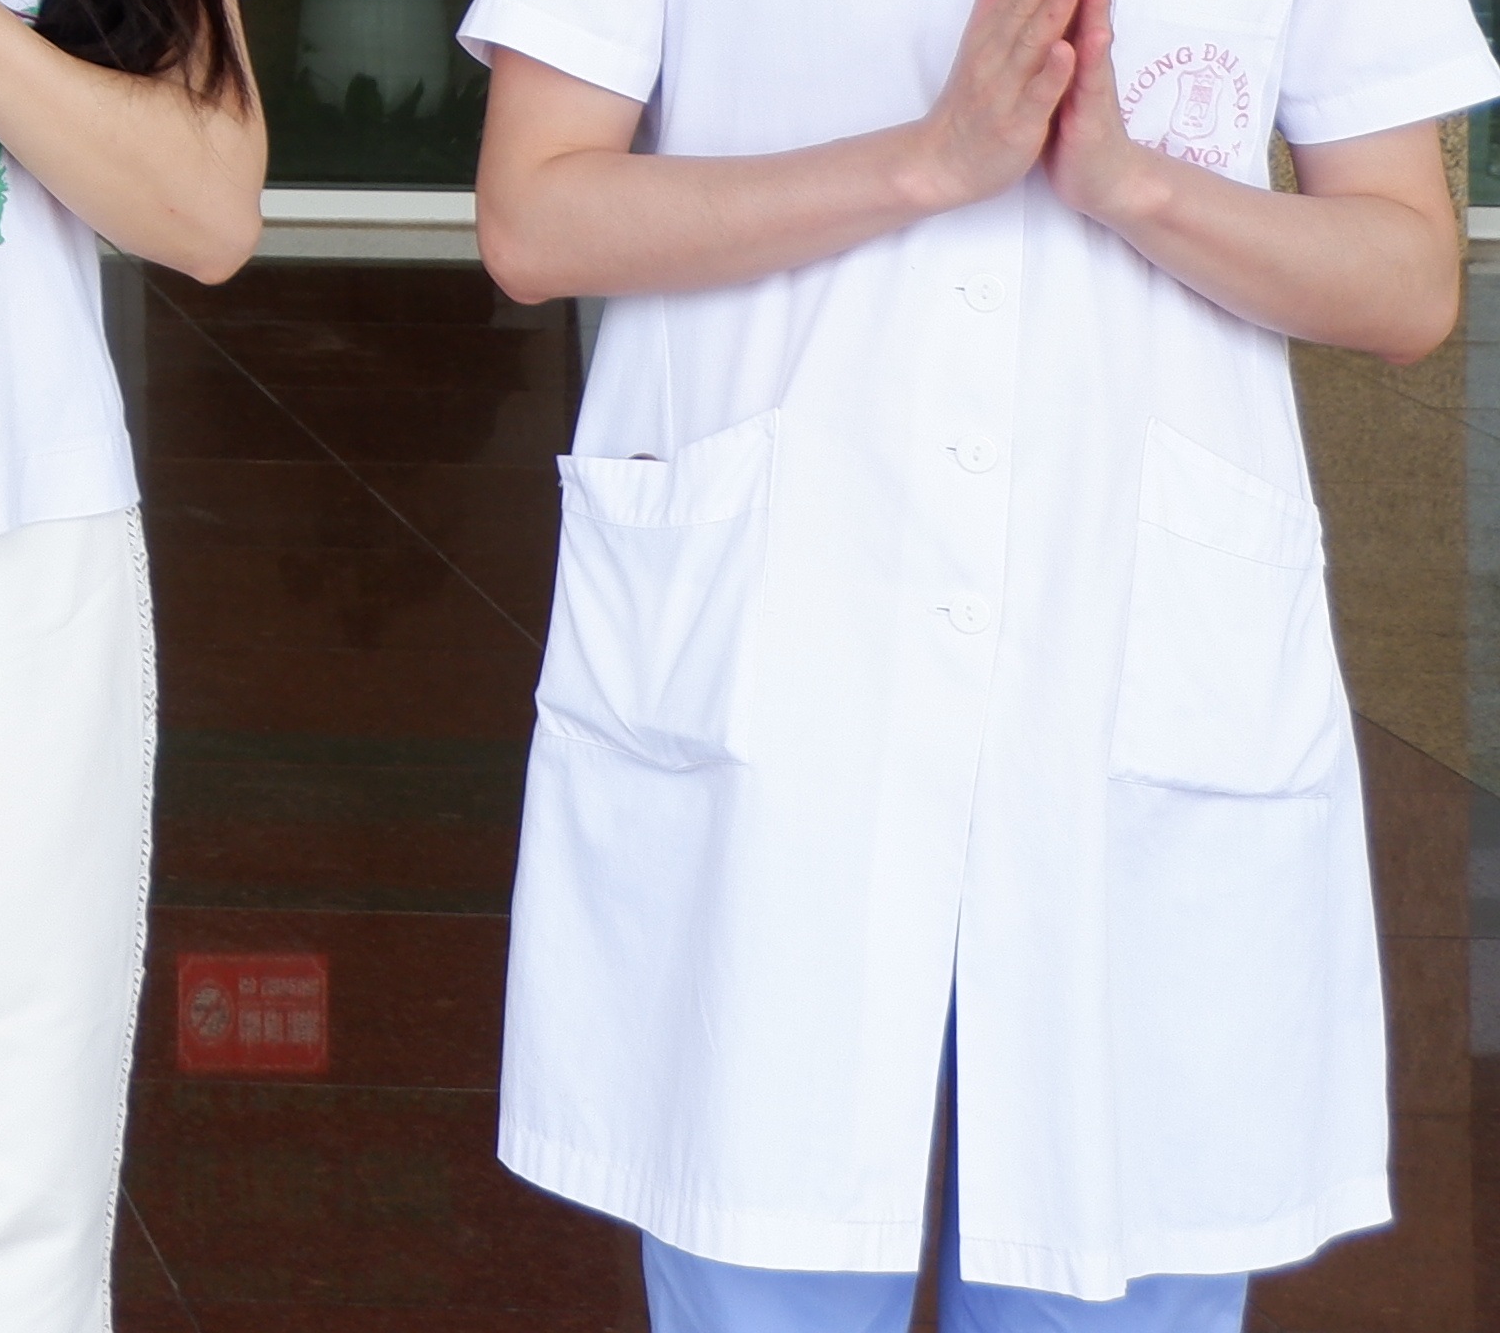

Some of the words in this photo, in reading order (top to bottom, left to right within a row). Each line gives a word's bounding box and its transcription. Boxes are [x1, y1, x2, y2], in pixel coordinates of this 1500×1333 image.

[1201, 42, 1240, 74] ĐẠI
[1232, 72, 1251, 130] HỌC
[1181, 144, 1230, 169] NỘI
